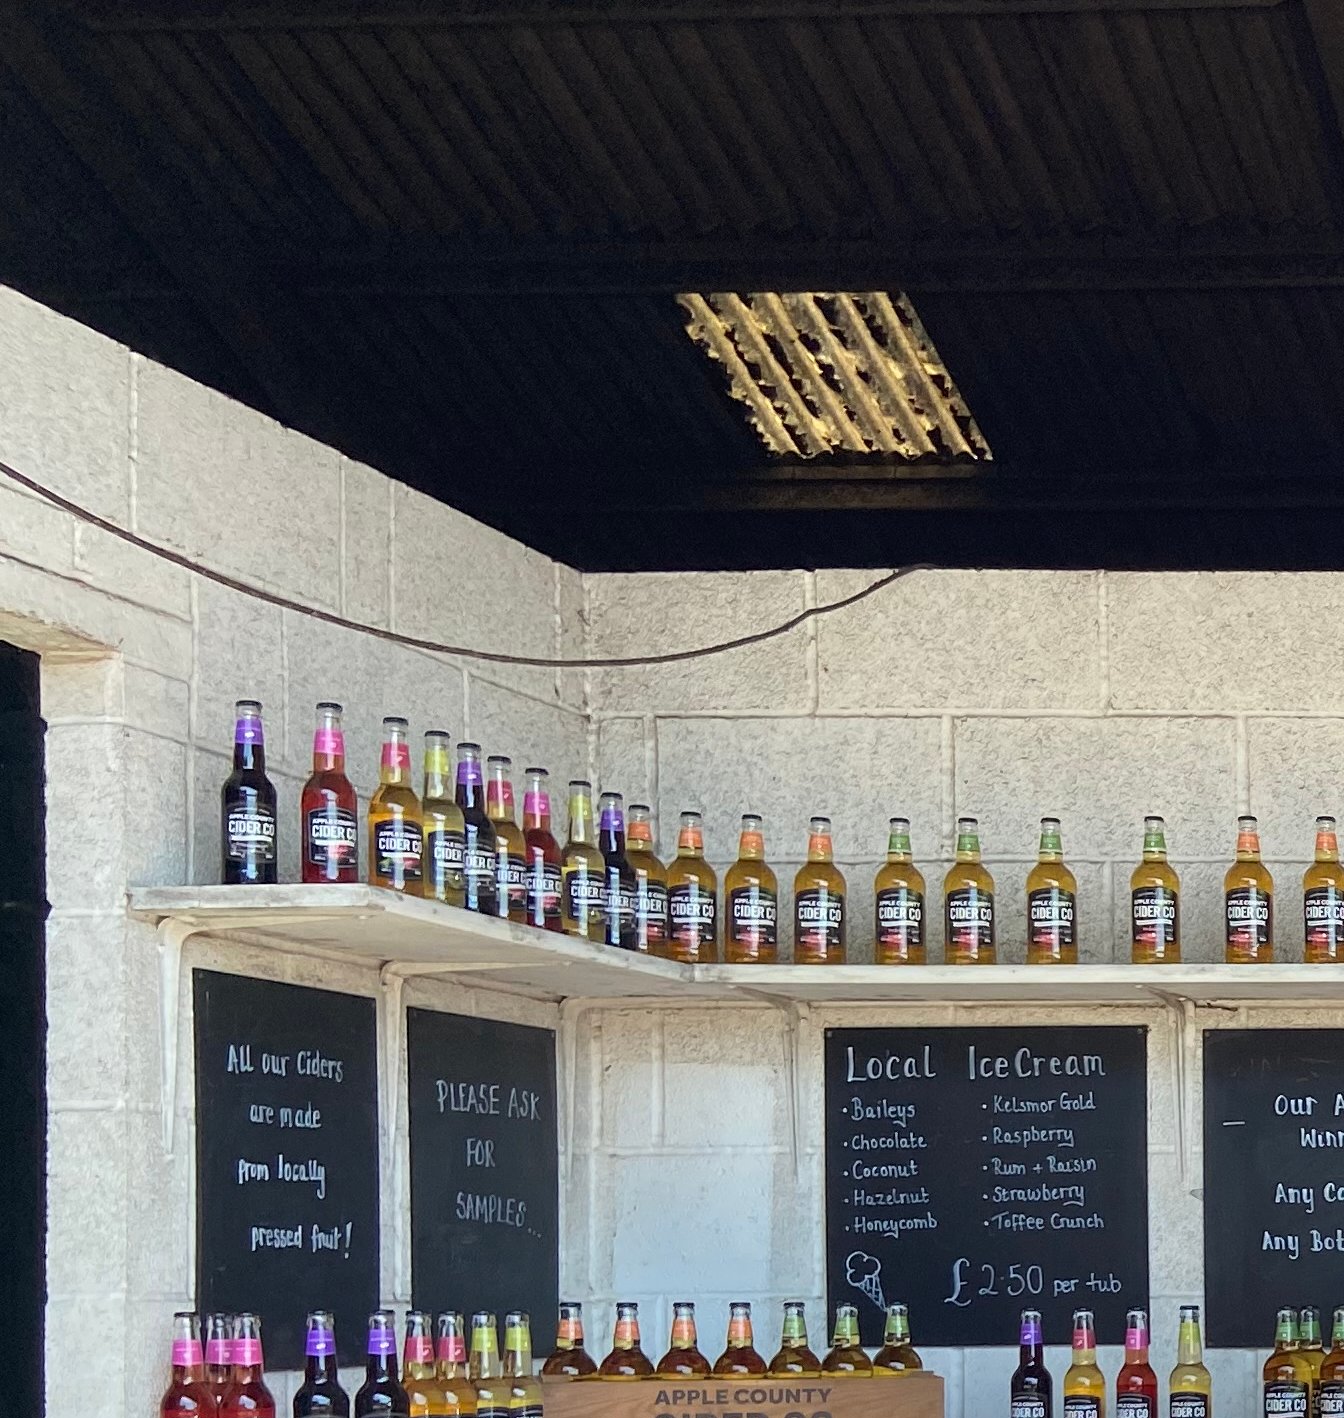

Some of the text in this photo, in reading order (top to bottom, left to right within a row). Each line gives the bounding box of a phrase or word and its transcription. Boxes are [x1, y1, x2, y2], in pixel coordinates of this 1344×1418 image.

[227, 1045, 254, 1073] All
[262, 1054, 290, 1077] our
[847, 1046, 937, 1082] Local
[436, 1079, 541, 1120] PLEASE ASK
[851, 1097, 915, 1127] Baileys
[1060, 1092, 1096, 1111] Gold
[1274, 1094, 1318, 1116] Our
[250, 1102, 322, 1129] are made
[852, 1133, 928, 1150] Chocolate
[992, 1126, 1074, 1148] Raspberry
[466, 1138, 495, 1168] FOR
[992, 1156, 1097, 1175] Rum Raisin
[278, 1154, 326, 1199] locally
[853, 1159, 919, 1179] Coconut
[854, 1187, 930, 1206] Hazelnut
[992, 1184, 1085, 1206] Strawberry
[1275, 1183, 1315, 1214] Any
[854, 1212, 938, 1238] Honeycomb
[992, 1212, 1104, 1230] Toffee Crunch
[252, 1225, 302, 1251] pressed
[1262, 1230, 1300, 1260] Any
[1053, 1278, 1078, 1297] per
[1085, 1273, 1122, 1294] tub
[654, 1388, 833, 1406] APPLE COUNTY
